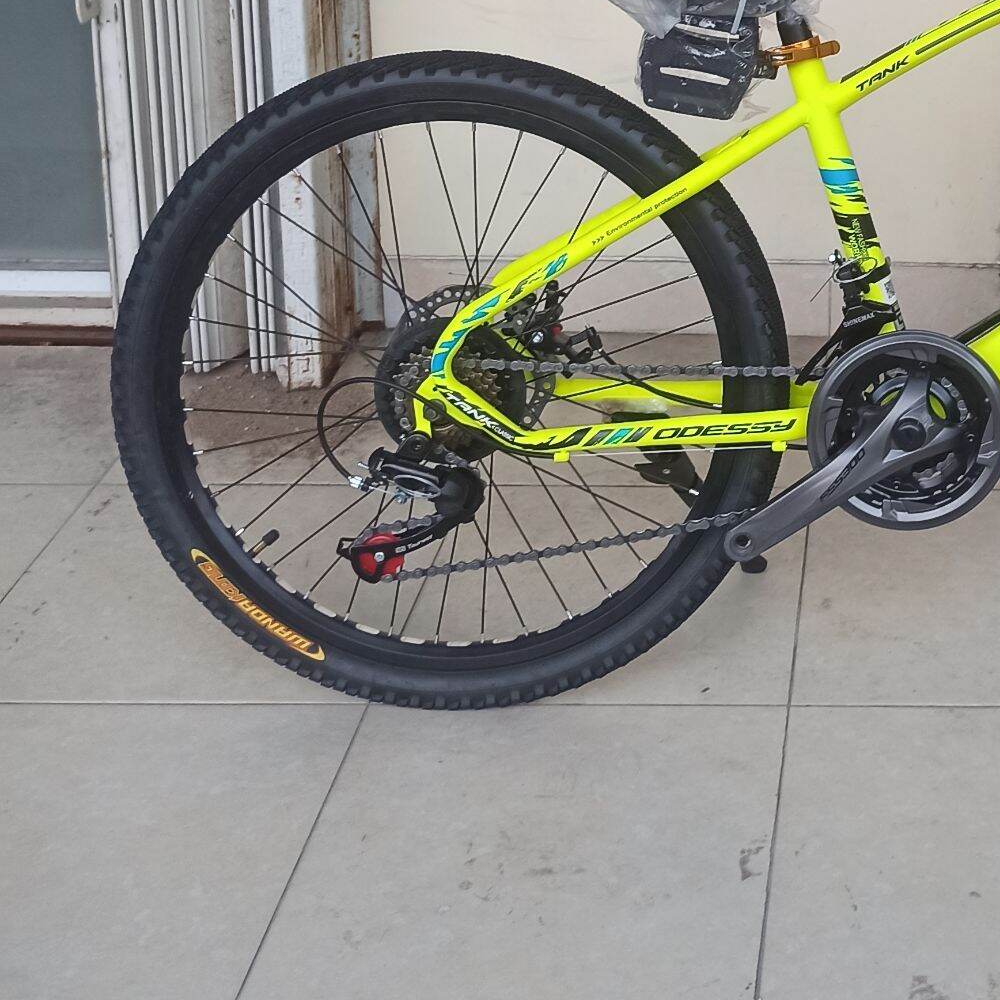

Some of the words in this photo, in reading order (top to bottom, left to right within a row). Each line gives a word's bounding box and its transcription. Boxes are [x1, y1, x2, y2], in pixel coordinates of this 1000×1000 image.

[856, 55, 909, 92] TANK
[606, 206, 653, 236] Environmental
[654, 187, 688, 210] protection
[446, 391, 500, 429] TANK
[653, 418, 797, 440] ODESSY
[236, 598, 315, 652] WANDA
